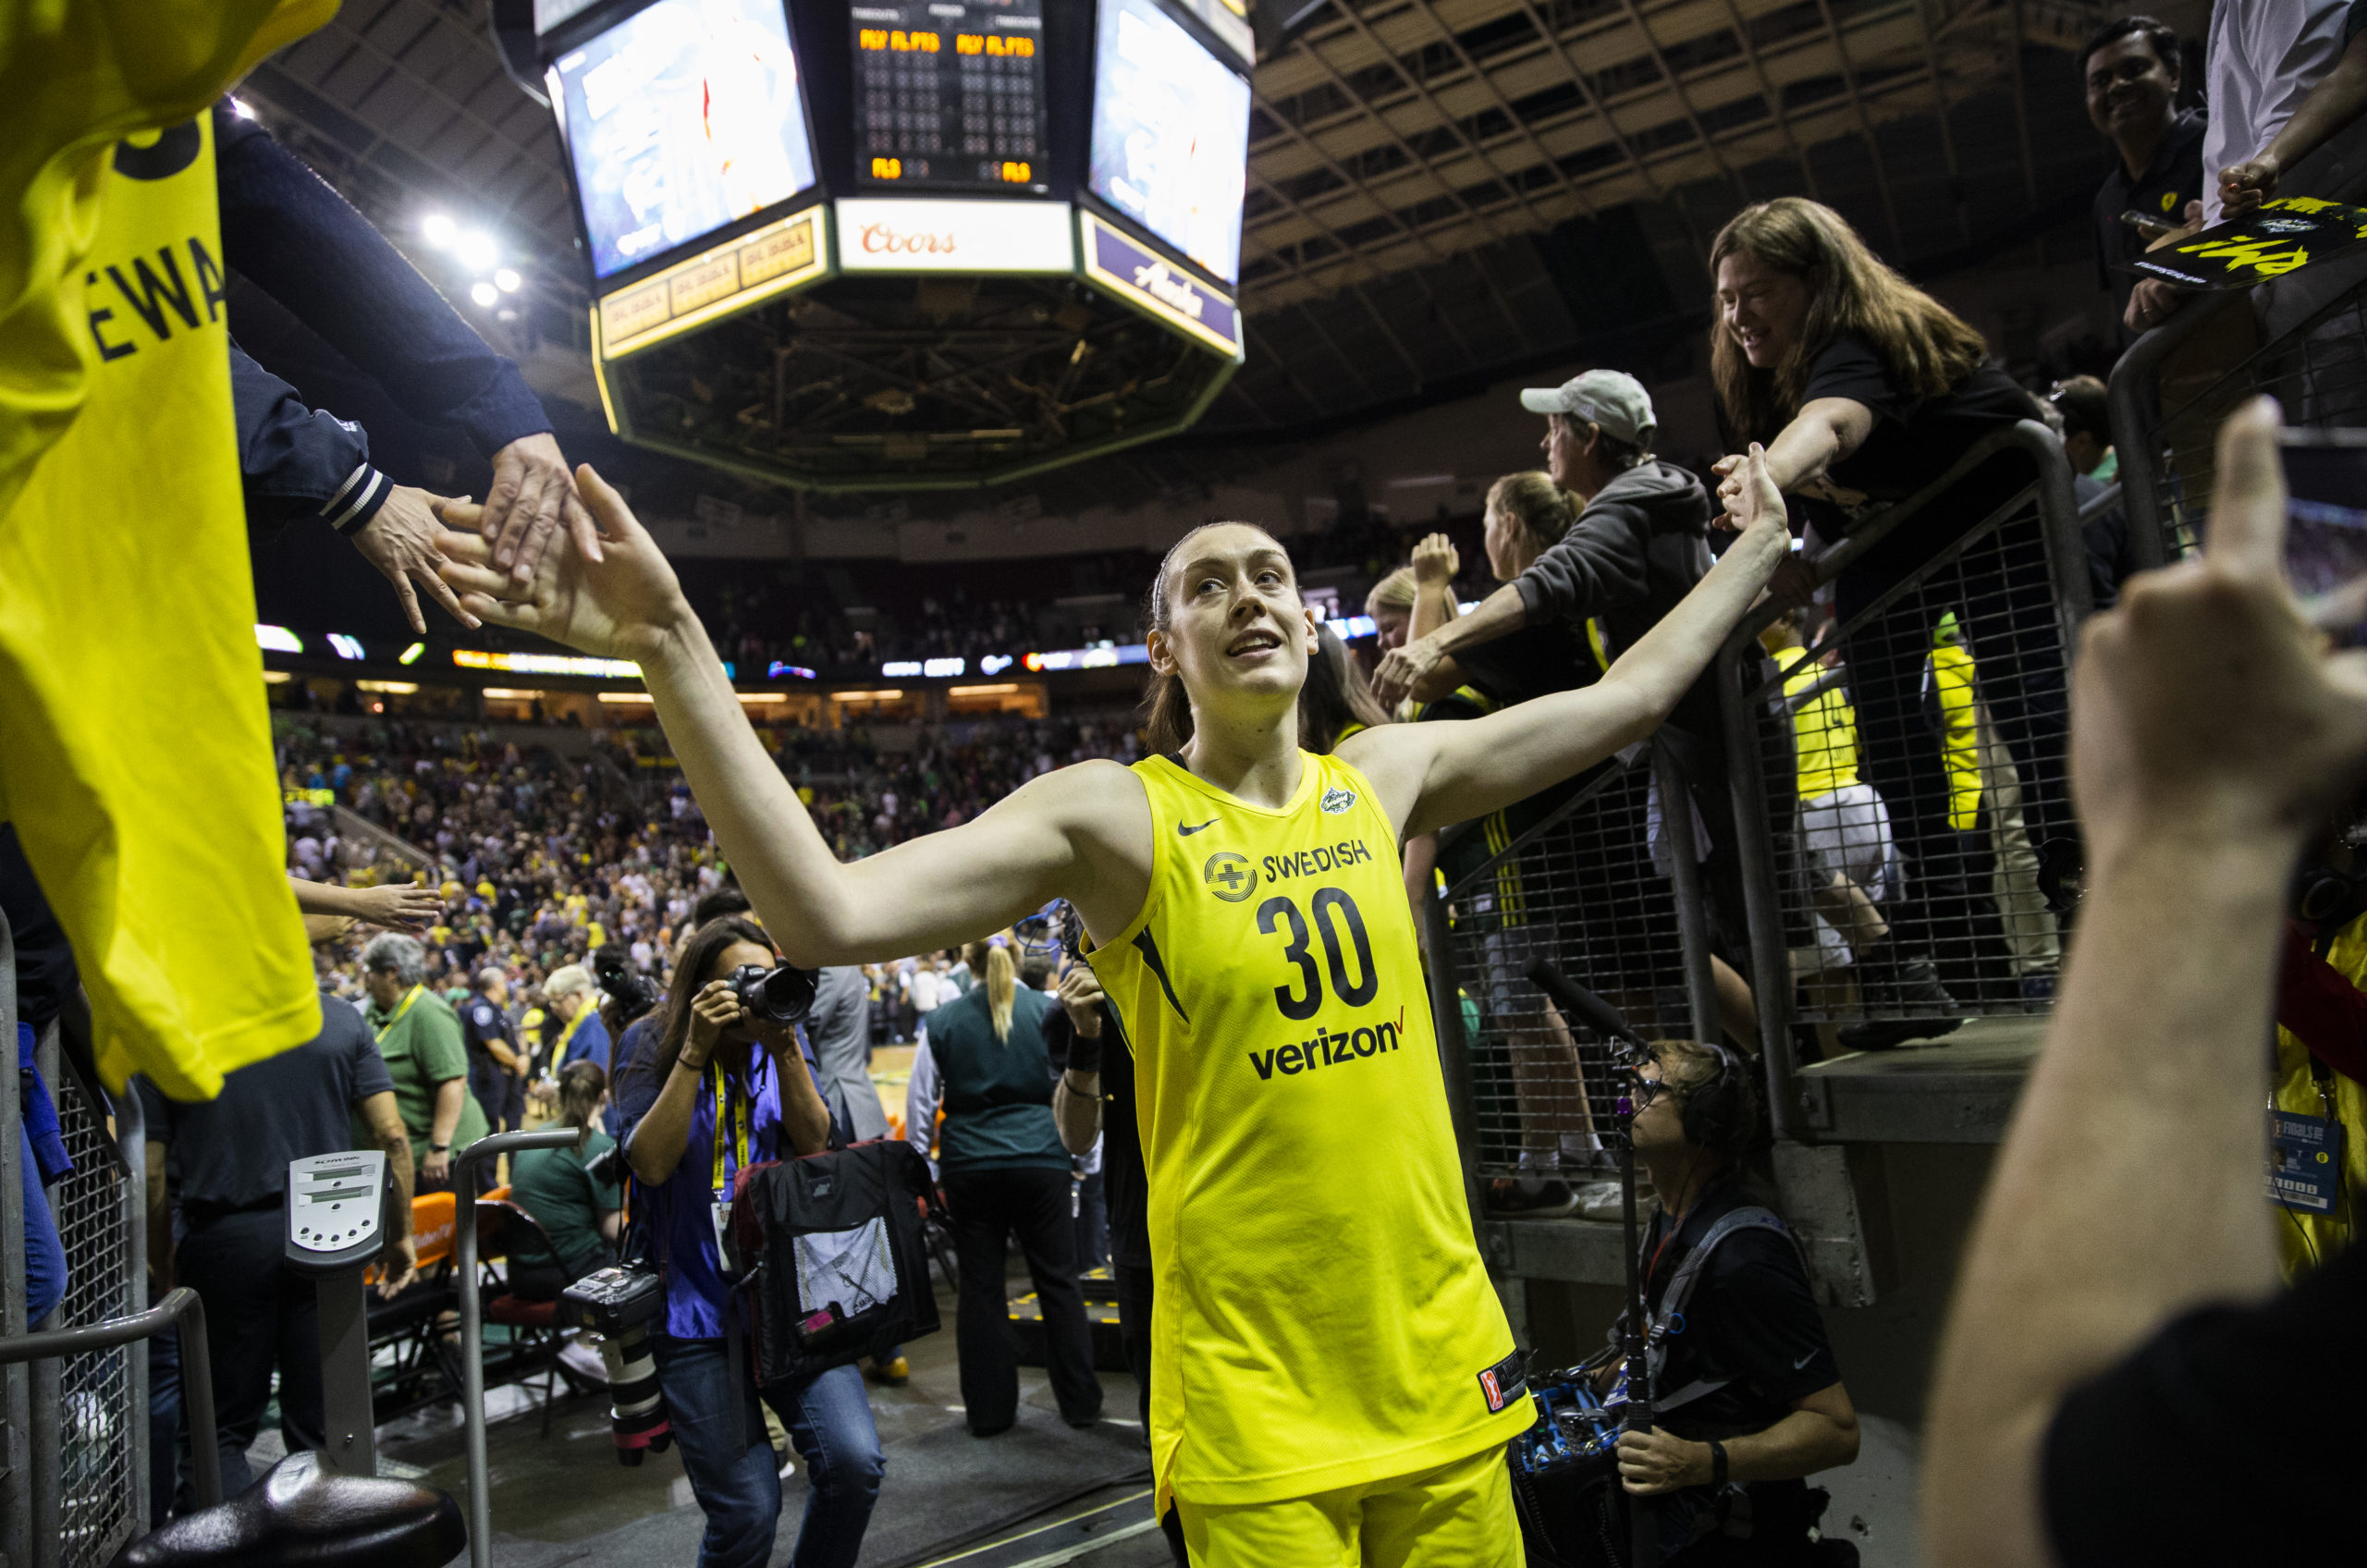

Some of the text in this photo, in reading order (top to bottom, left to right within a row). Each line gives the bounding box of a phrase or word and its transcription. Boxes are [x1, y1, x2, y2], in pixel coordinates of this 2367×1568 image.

[860, 222, 956, 254] Coors
[1263, 839, 1373, 884] SWEDISH
[1256, 887, 1379, 1021] 30
[1249, 1021, 1400, 1080] verizon
